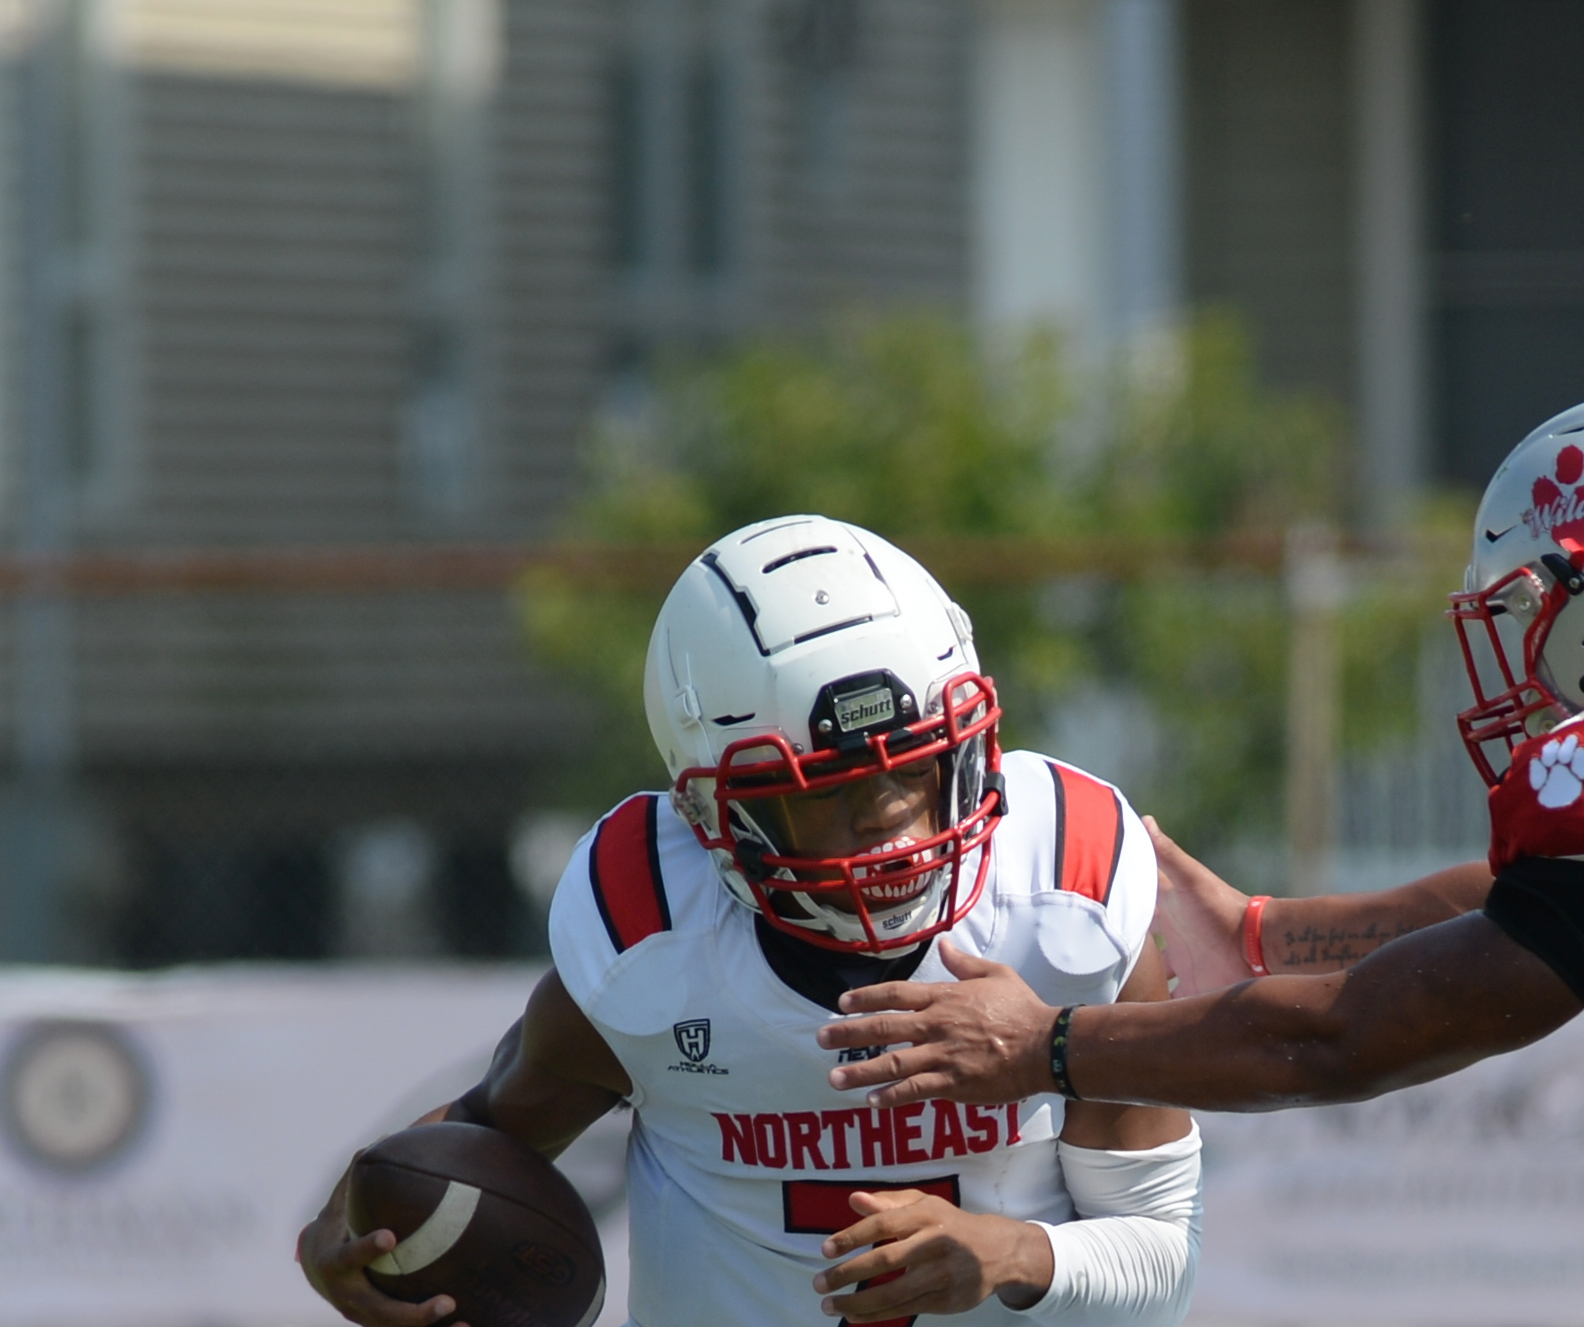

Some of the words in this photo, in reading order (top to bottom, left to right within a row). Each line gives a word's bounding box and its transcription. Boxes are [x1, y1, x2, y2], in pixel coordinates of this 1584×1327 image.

[841, 699, 891, 724] schutt
[882, 911, 912, 929] schutt
[710, 1099, 1025, 1169] NORTHEAST
